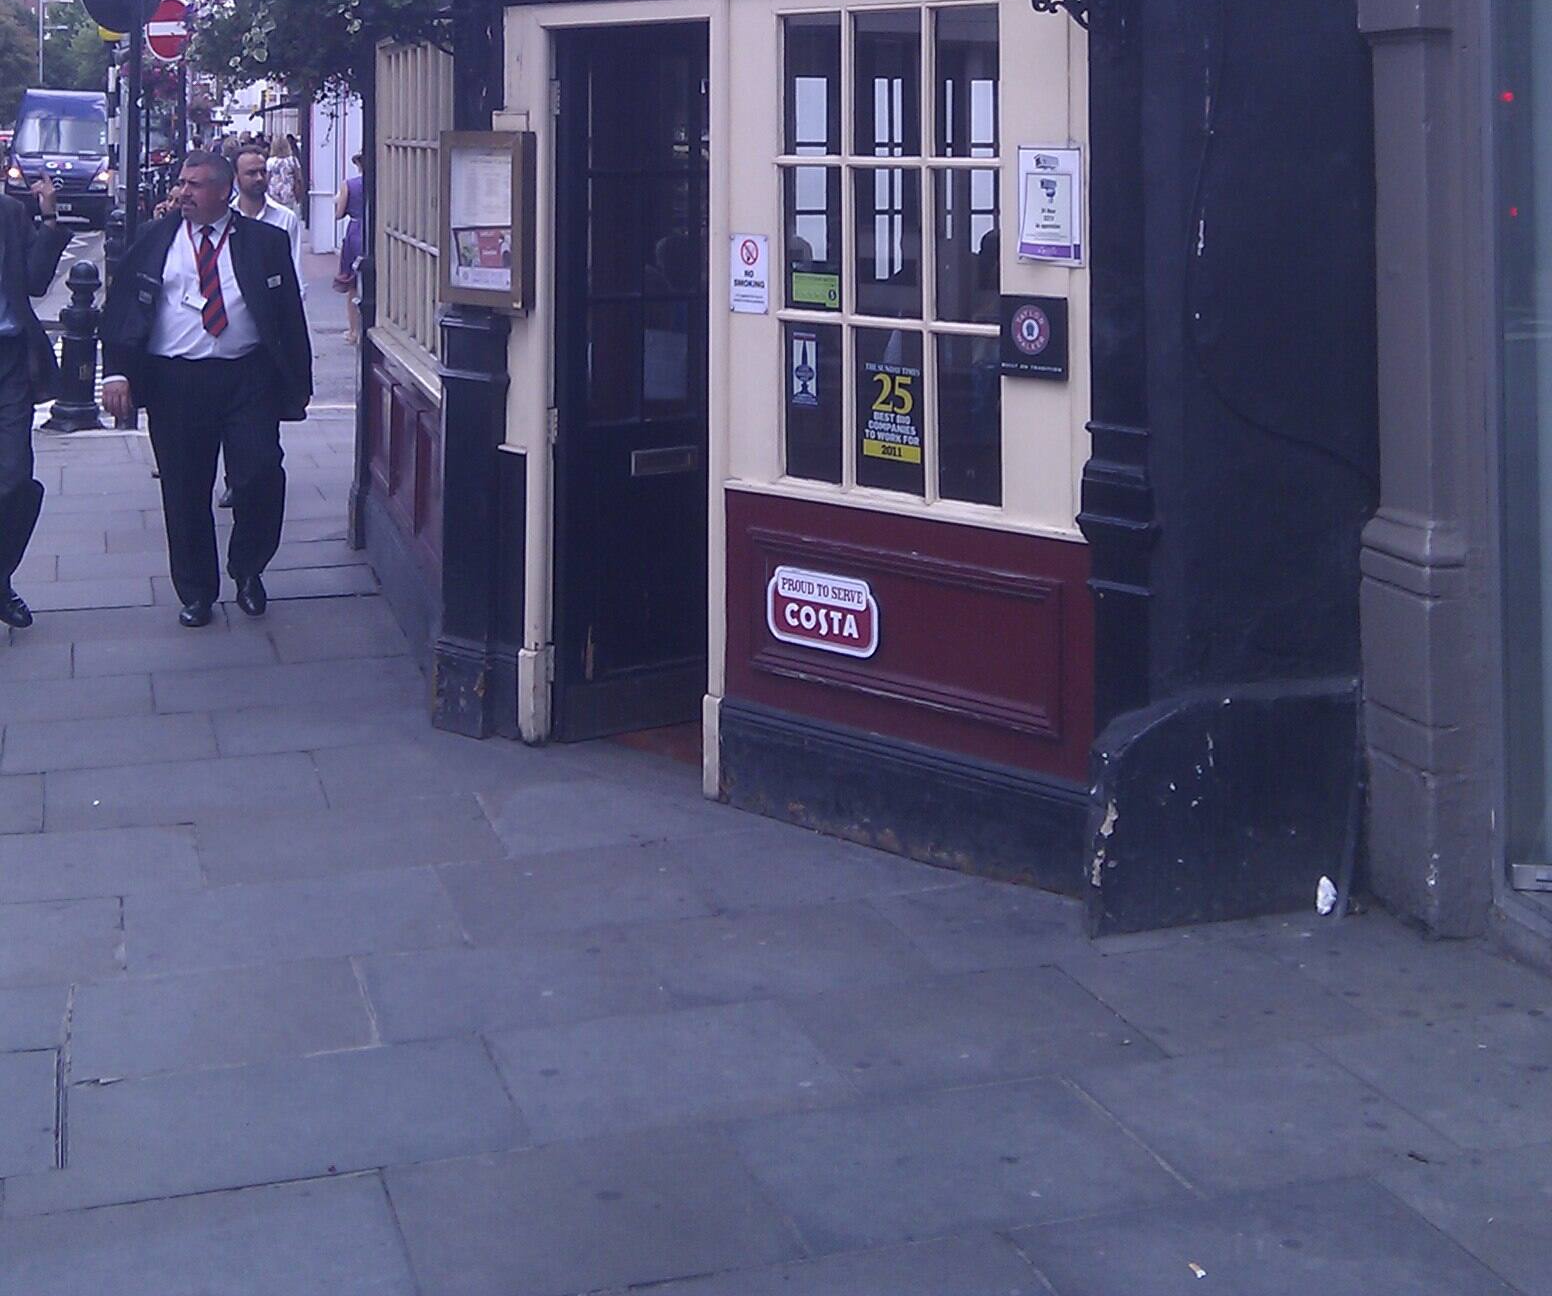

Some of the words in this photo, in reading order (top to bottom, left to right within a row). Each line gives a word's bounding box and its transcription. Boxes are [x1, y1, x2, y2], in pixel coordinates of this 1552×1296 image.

[744, 270, 754, 279] NO
[734, 279, 765, 289] SMOKING
[872, 373, 913, 414] 25
[873, 411, 895, 423] BEST
[868, 420, 916, 435] COMPANIES
[865, 429, 876, 439] TO
[877, 431, 902, 443] WORK
[903, 435, 920, 446] FOR
[881, 444, 903, 457] 2011
[781, 577, 814, 595] PROUD
[817, 584, 829, 598] TO
[831, 586, 863, 604] SERVE
[785, 602, 859, 639] COSTA
